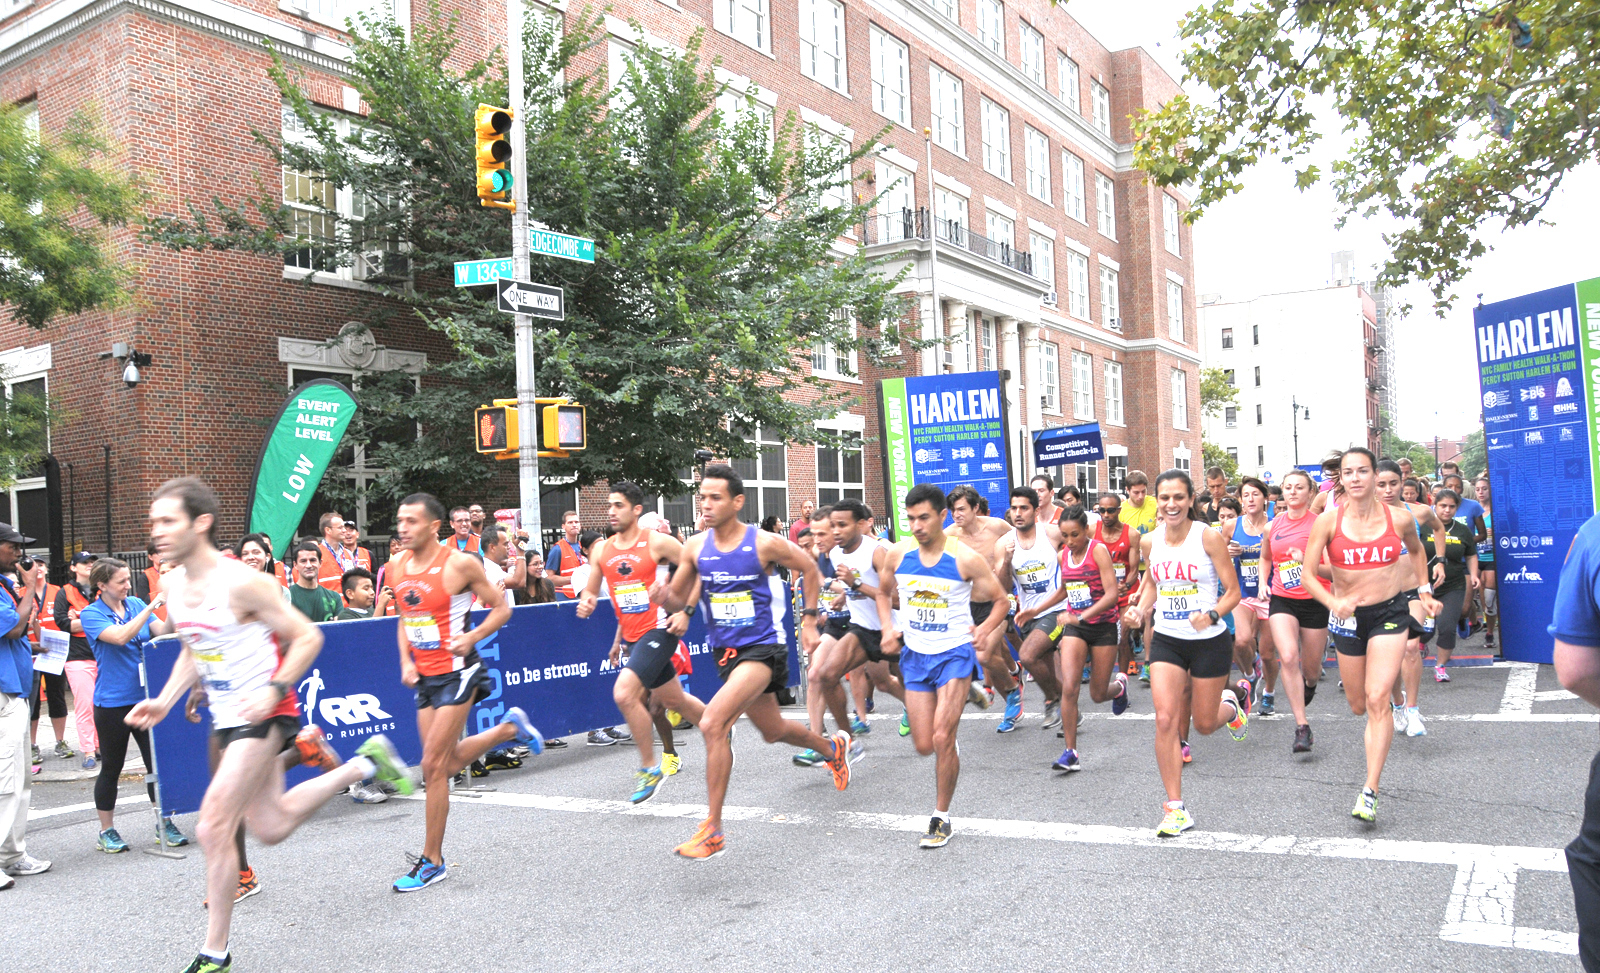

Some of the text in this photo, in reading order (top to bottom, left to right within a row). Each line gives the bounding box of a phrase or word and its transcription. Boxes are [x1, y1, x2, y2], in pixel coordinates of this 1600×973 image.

[530, 230, 592, 257] EDGECOMBE AV
[457, 260, 512, 283] W 136 ST
[509, 290, 555, 309] ONE WAY
[1478, 306, 1575, 363] HARLEM
[1482, 349, 1576, 376] NYC FAMILY HEALTH WALK-A-THON
[1483, 360, 1576, 386] PERCY SUTTON HARLEM 5K RUN
[298, 398, 340, 414] EVENT
[910, 388, 1000, 425] HARLEM
[296, 413, 338, 428] ALERT
[888, 396, 903, 436] NEW
[295, 427, 334, 442] LEVEL
[913, 421, 1000, 436] NYC FAMILY HEALTH WALK-A-THON
[914, 430, 1001, 444] PERCY SUTTON HARLEM 5K RUN
[1039, 446, 1098, 461] Runner Check-in
[1046, 440, 1089, 452] Competitive
[891, 437, 908, 483] YORK
[282, 453, 315, 504] LOW
[895, 484, 912, 533] ROAD
[1343, 546, 1393, 565] NYAC
[1027, 572, 1038, 582] 46
[1152, 560, 1198, 583] NYAC
[1248, 566, 1258, 576] 10
[1168, 596, 1188, 610] 780
[917, 608, 936, 622] 919
[688, 642, 710, 656] in a
[506, 661, 591, 686] to be strong.
[319, 693, 392, 726] RR
[340, 722, 396, 739] RUNNERS
